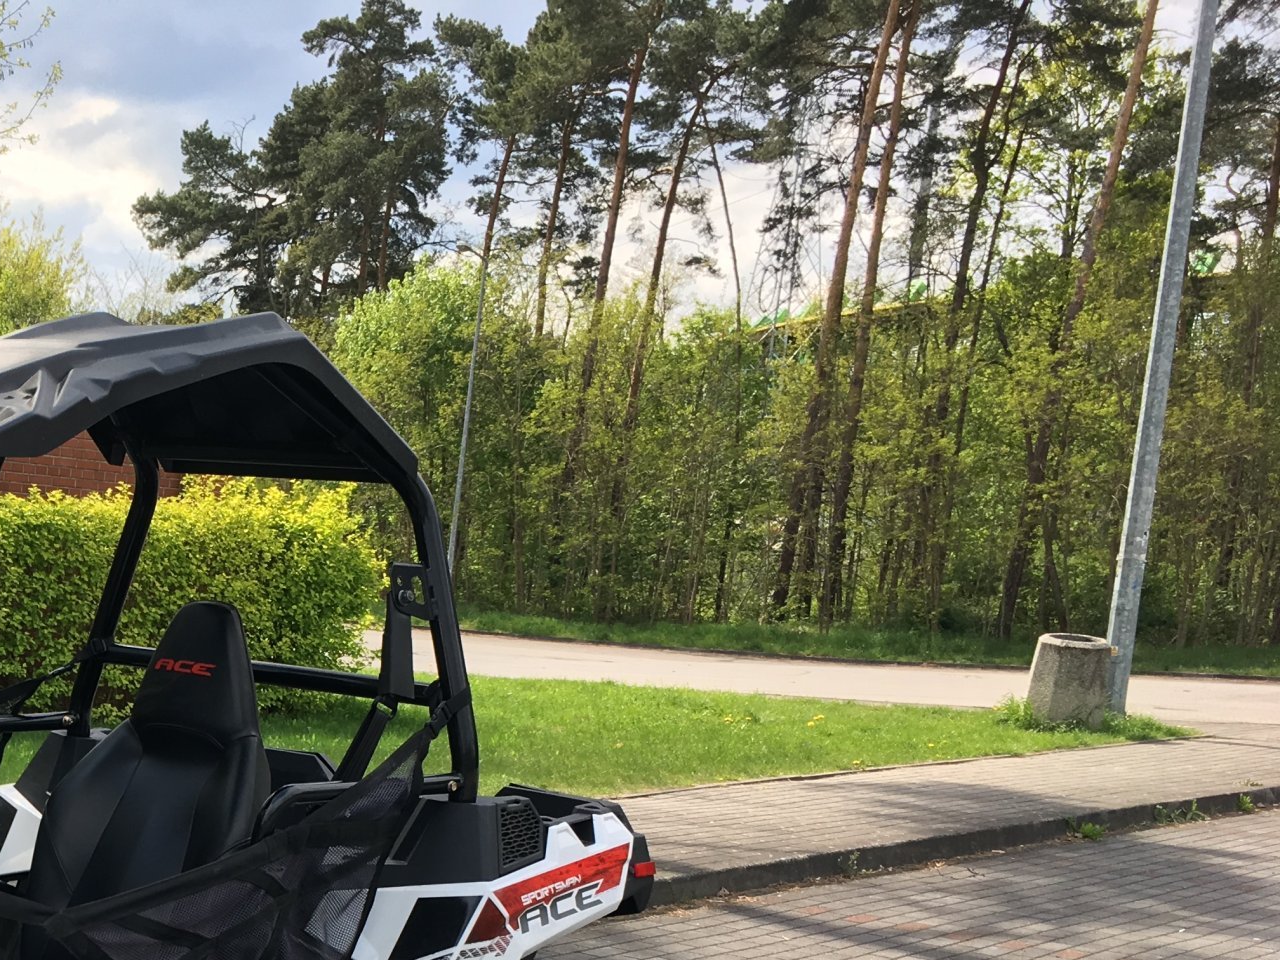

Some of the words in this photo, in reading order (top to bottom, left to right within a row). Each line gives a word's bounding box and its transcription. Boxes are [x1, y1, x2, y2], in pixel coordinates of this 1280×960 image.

[154, 658, 216, 676] ACE
[520, 874, 582, 906] SPORTSMAN
[520, 882, 604, 934] ACE
